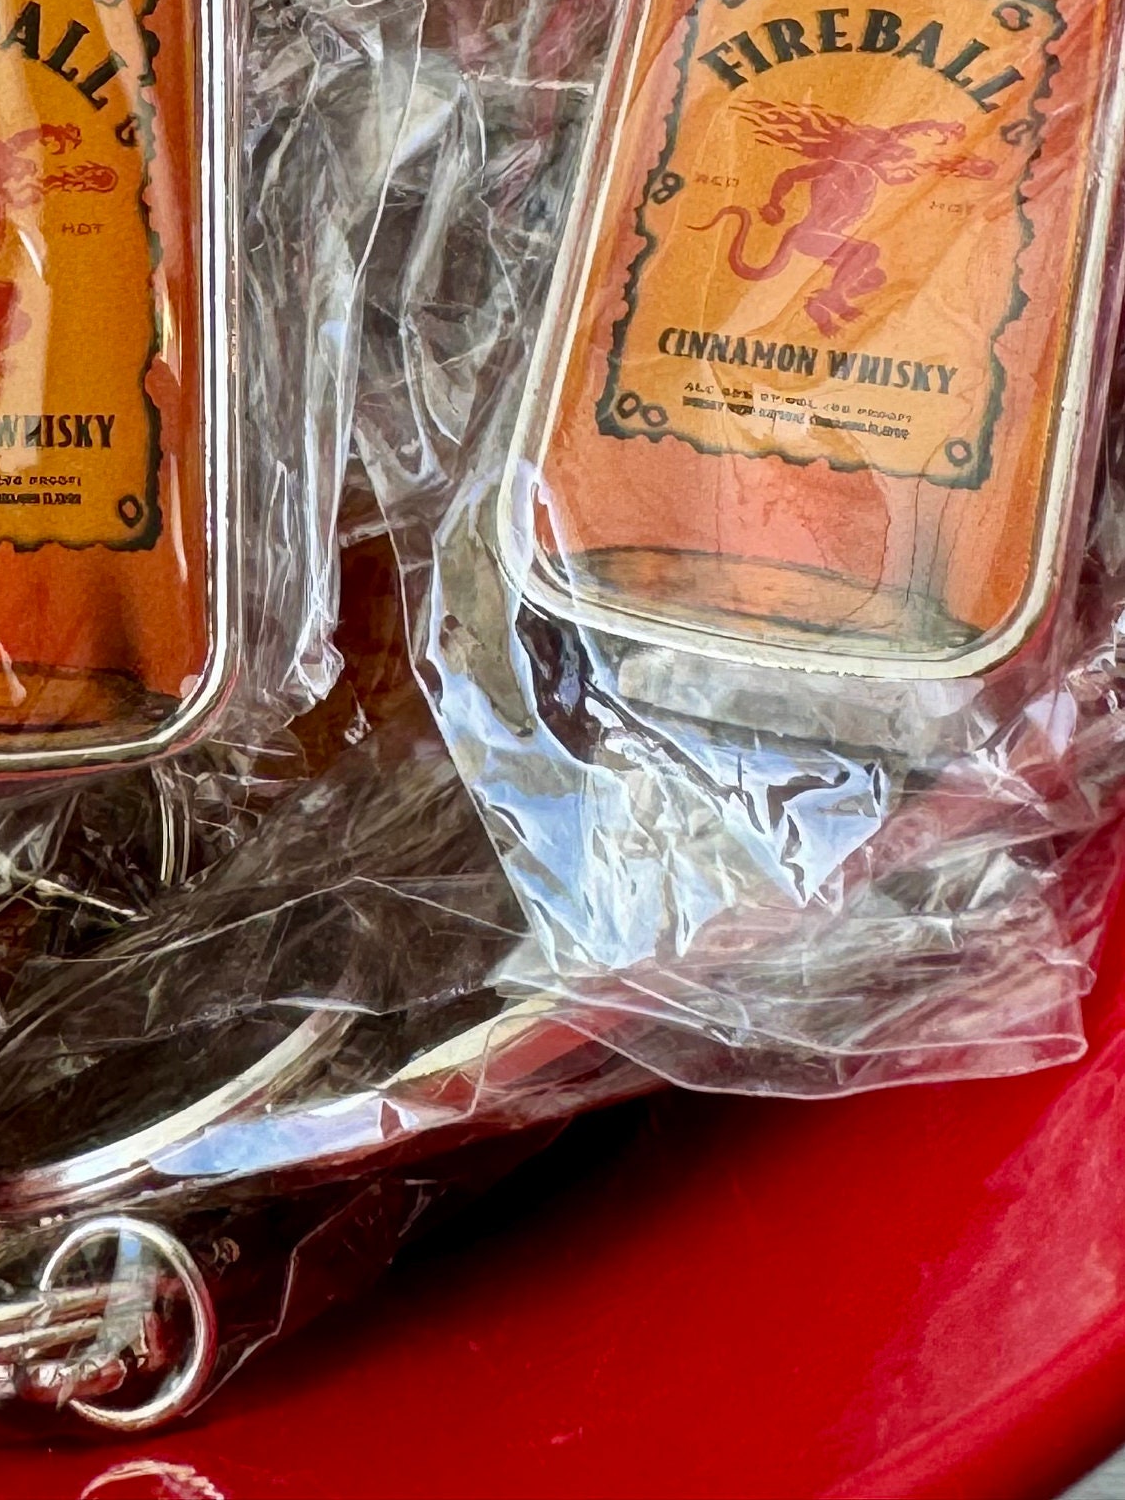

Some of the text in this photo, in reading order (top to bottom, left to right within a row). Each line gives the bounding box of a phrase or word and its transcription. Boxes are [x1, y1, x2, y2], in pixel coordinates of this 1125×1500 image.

[698, 7, 1025, 113] FIREBALL
[657, 327, 959, 395] CINNAMON WHISKY
